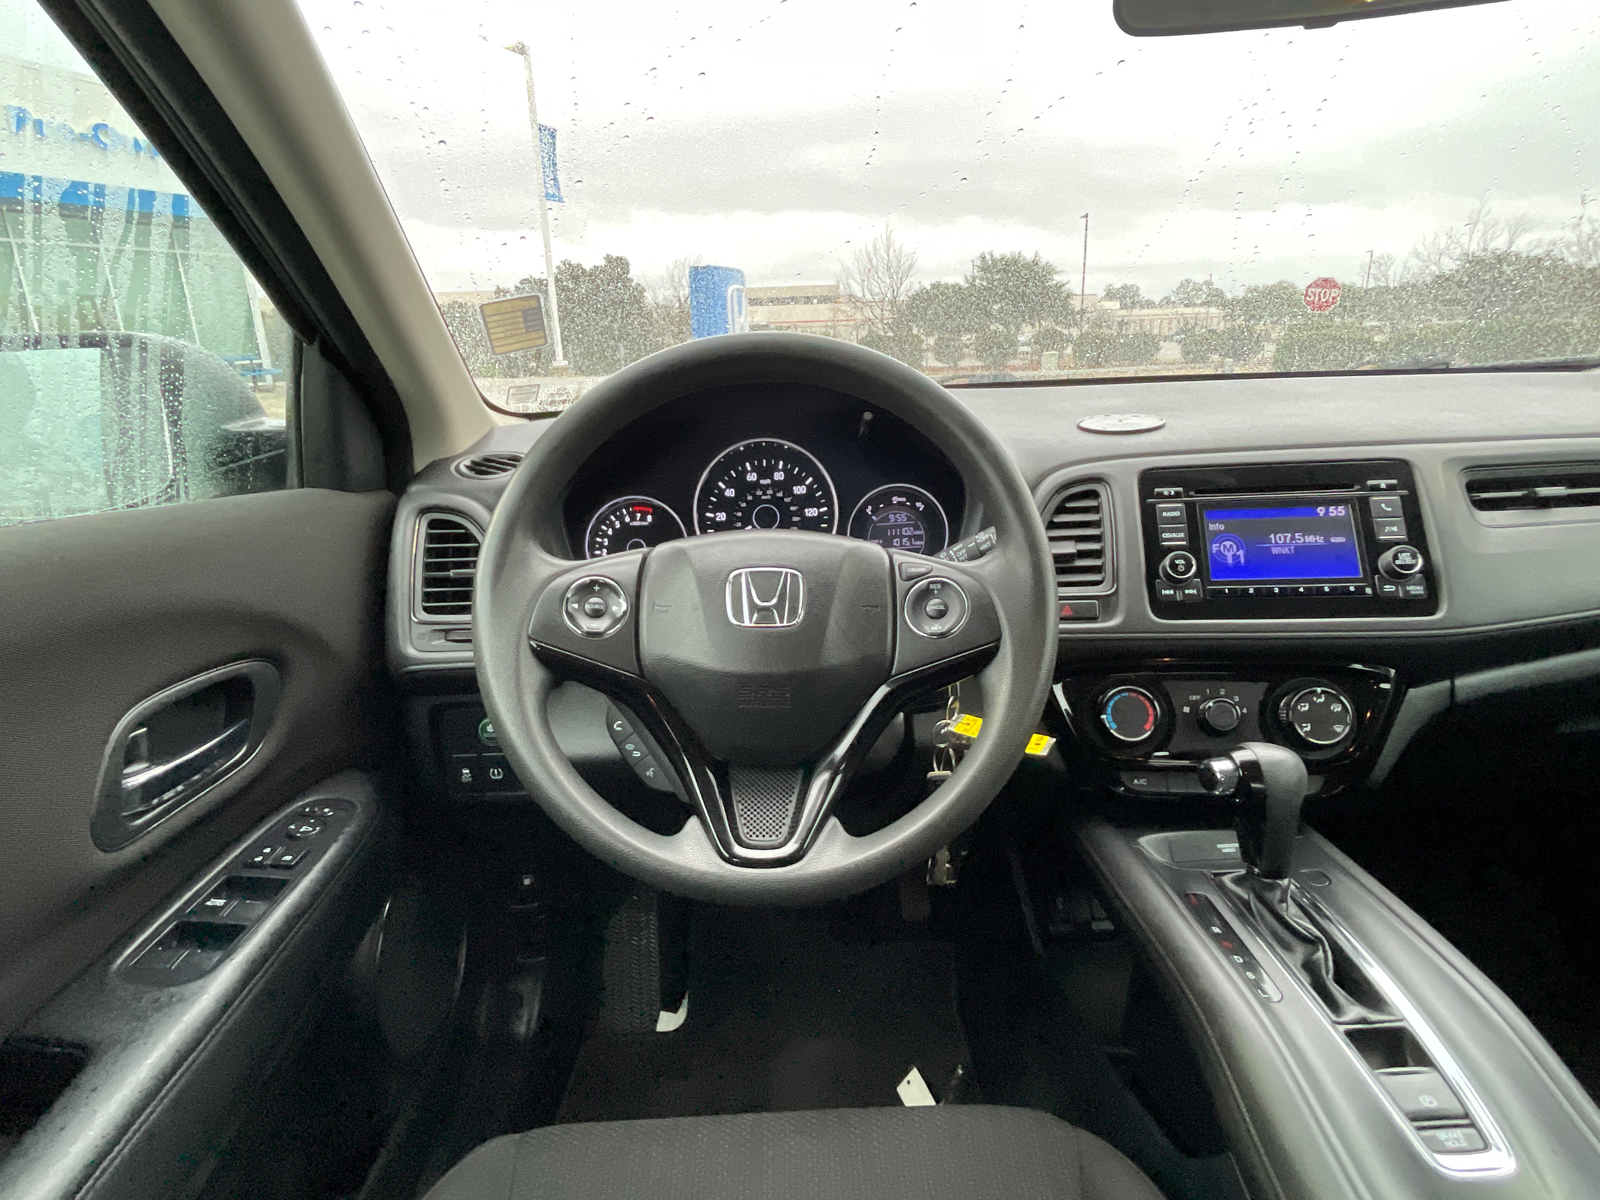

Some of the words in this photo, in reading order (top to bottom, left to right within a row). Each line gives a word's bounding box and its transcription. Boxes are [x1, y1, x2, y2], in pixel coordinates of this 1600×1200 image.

[1306, 288, 1339, 304] STOP
[746, 472, 757, 481] 60
[773, 471, 784, 480] 80
[724, 488, 735, 497] 40
[792, 485, 806, 494] 100
[635, 513, 641, 521] 7
[715, 512, 726, 521] 20
[804, 508, 818, 517] 120
[624, 515, 630, 523] 6
[646, 514, 652, 522] 8
[888, 513, 907, 522] 9:55
[614, 520, 620, 528] 5
[1208, 522, 1225, 531] Info
[1269, 533, 1304, 543] 107.5
[1305, 535, 1325, 543] MHz
[602, 548, 607, 556] 2
[1271, 546, 1295, 555] WNKT
[1233, 955, 1244, 963] D
